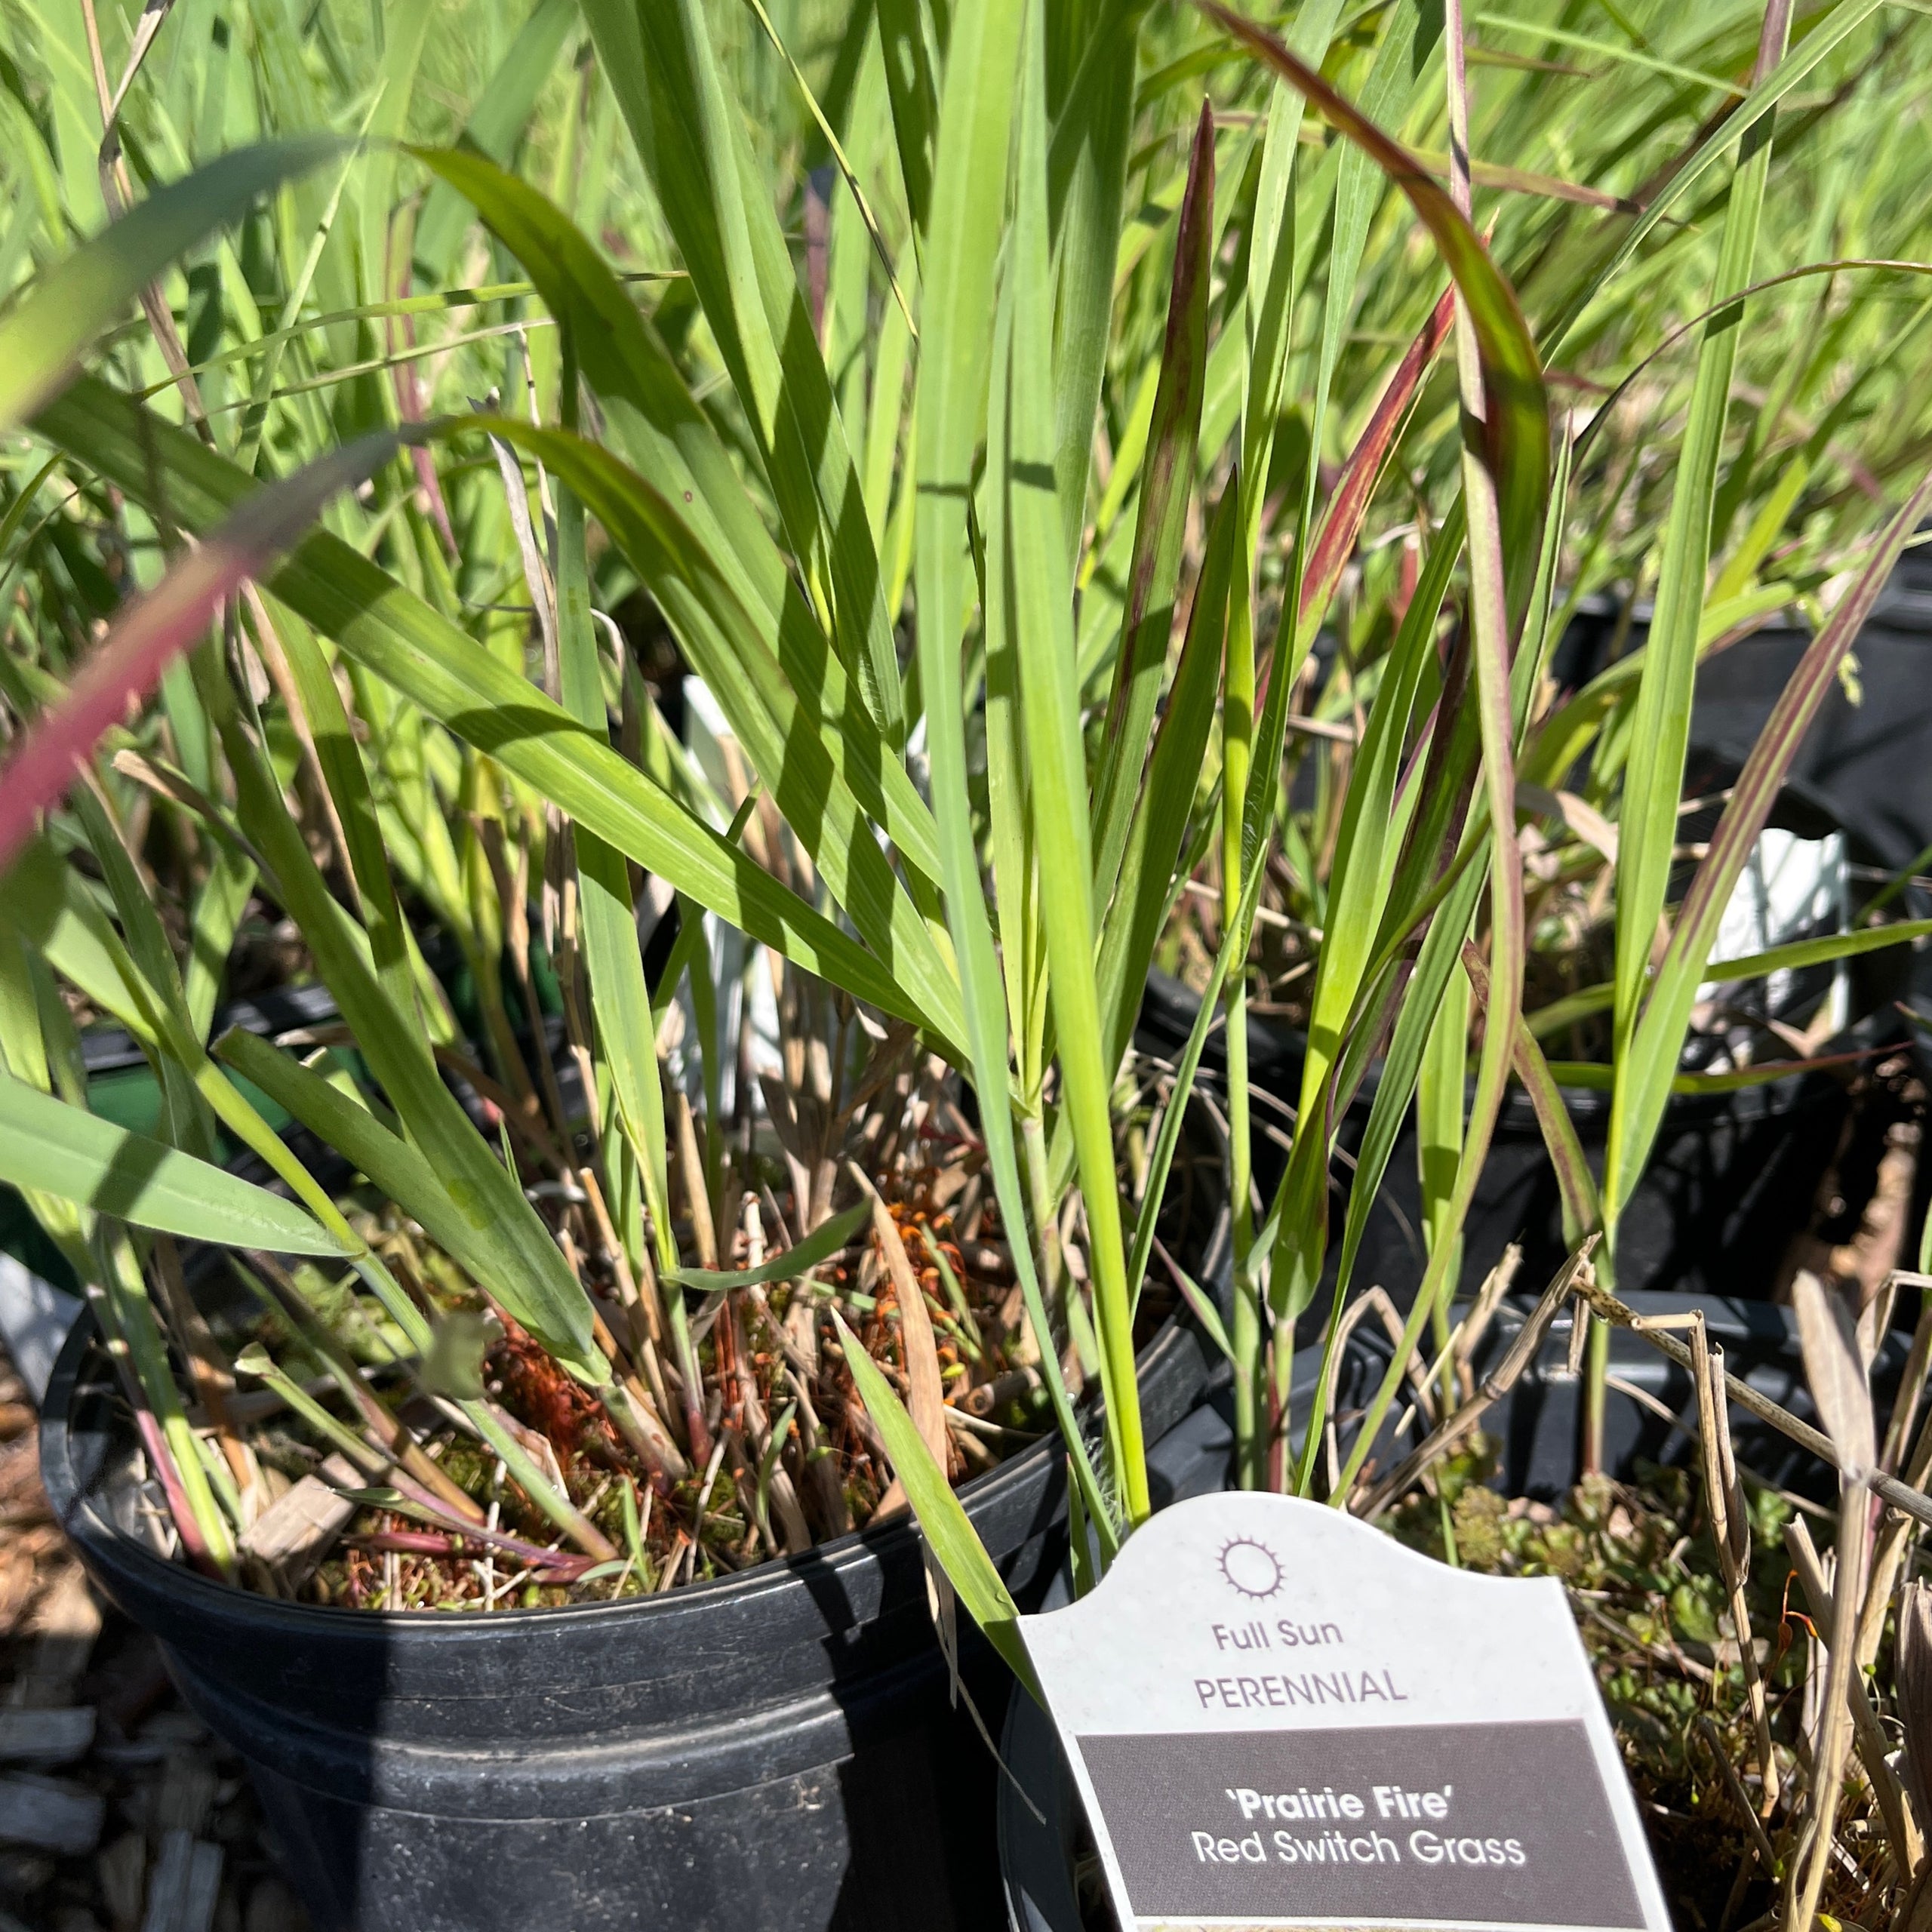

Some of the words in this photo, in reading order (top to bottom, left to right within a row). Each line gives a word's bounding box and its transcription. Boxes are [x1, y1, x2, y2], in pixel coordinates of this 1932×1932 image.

[1211, 1621, 1270, 1651] Full
[1277, 1619, 1344, 1647] Sun
[1194, 1669, 1408, 1709] PERENNIAL
[1190, 1831, 1268, 1863] Red
[1274, 1829, 1401, 1863] Switch
[1408, 1829, 1527, 1865] Grass
